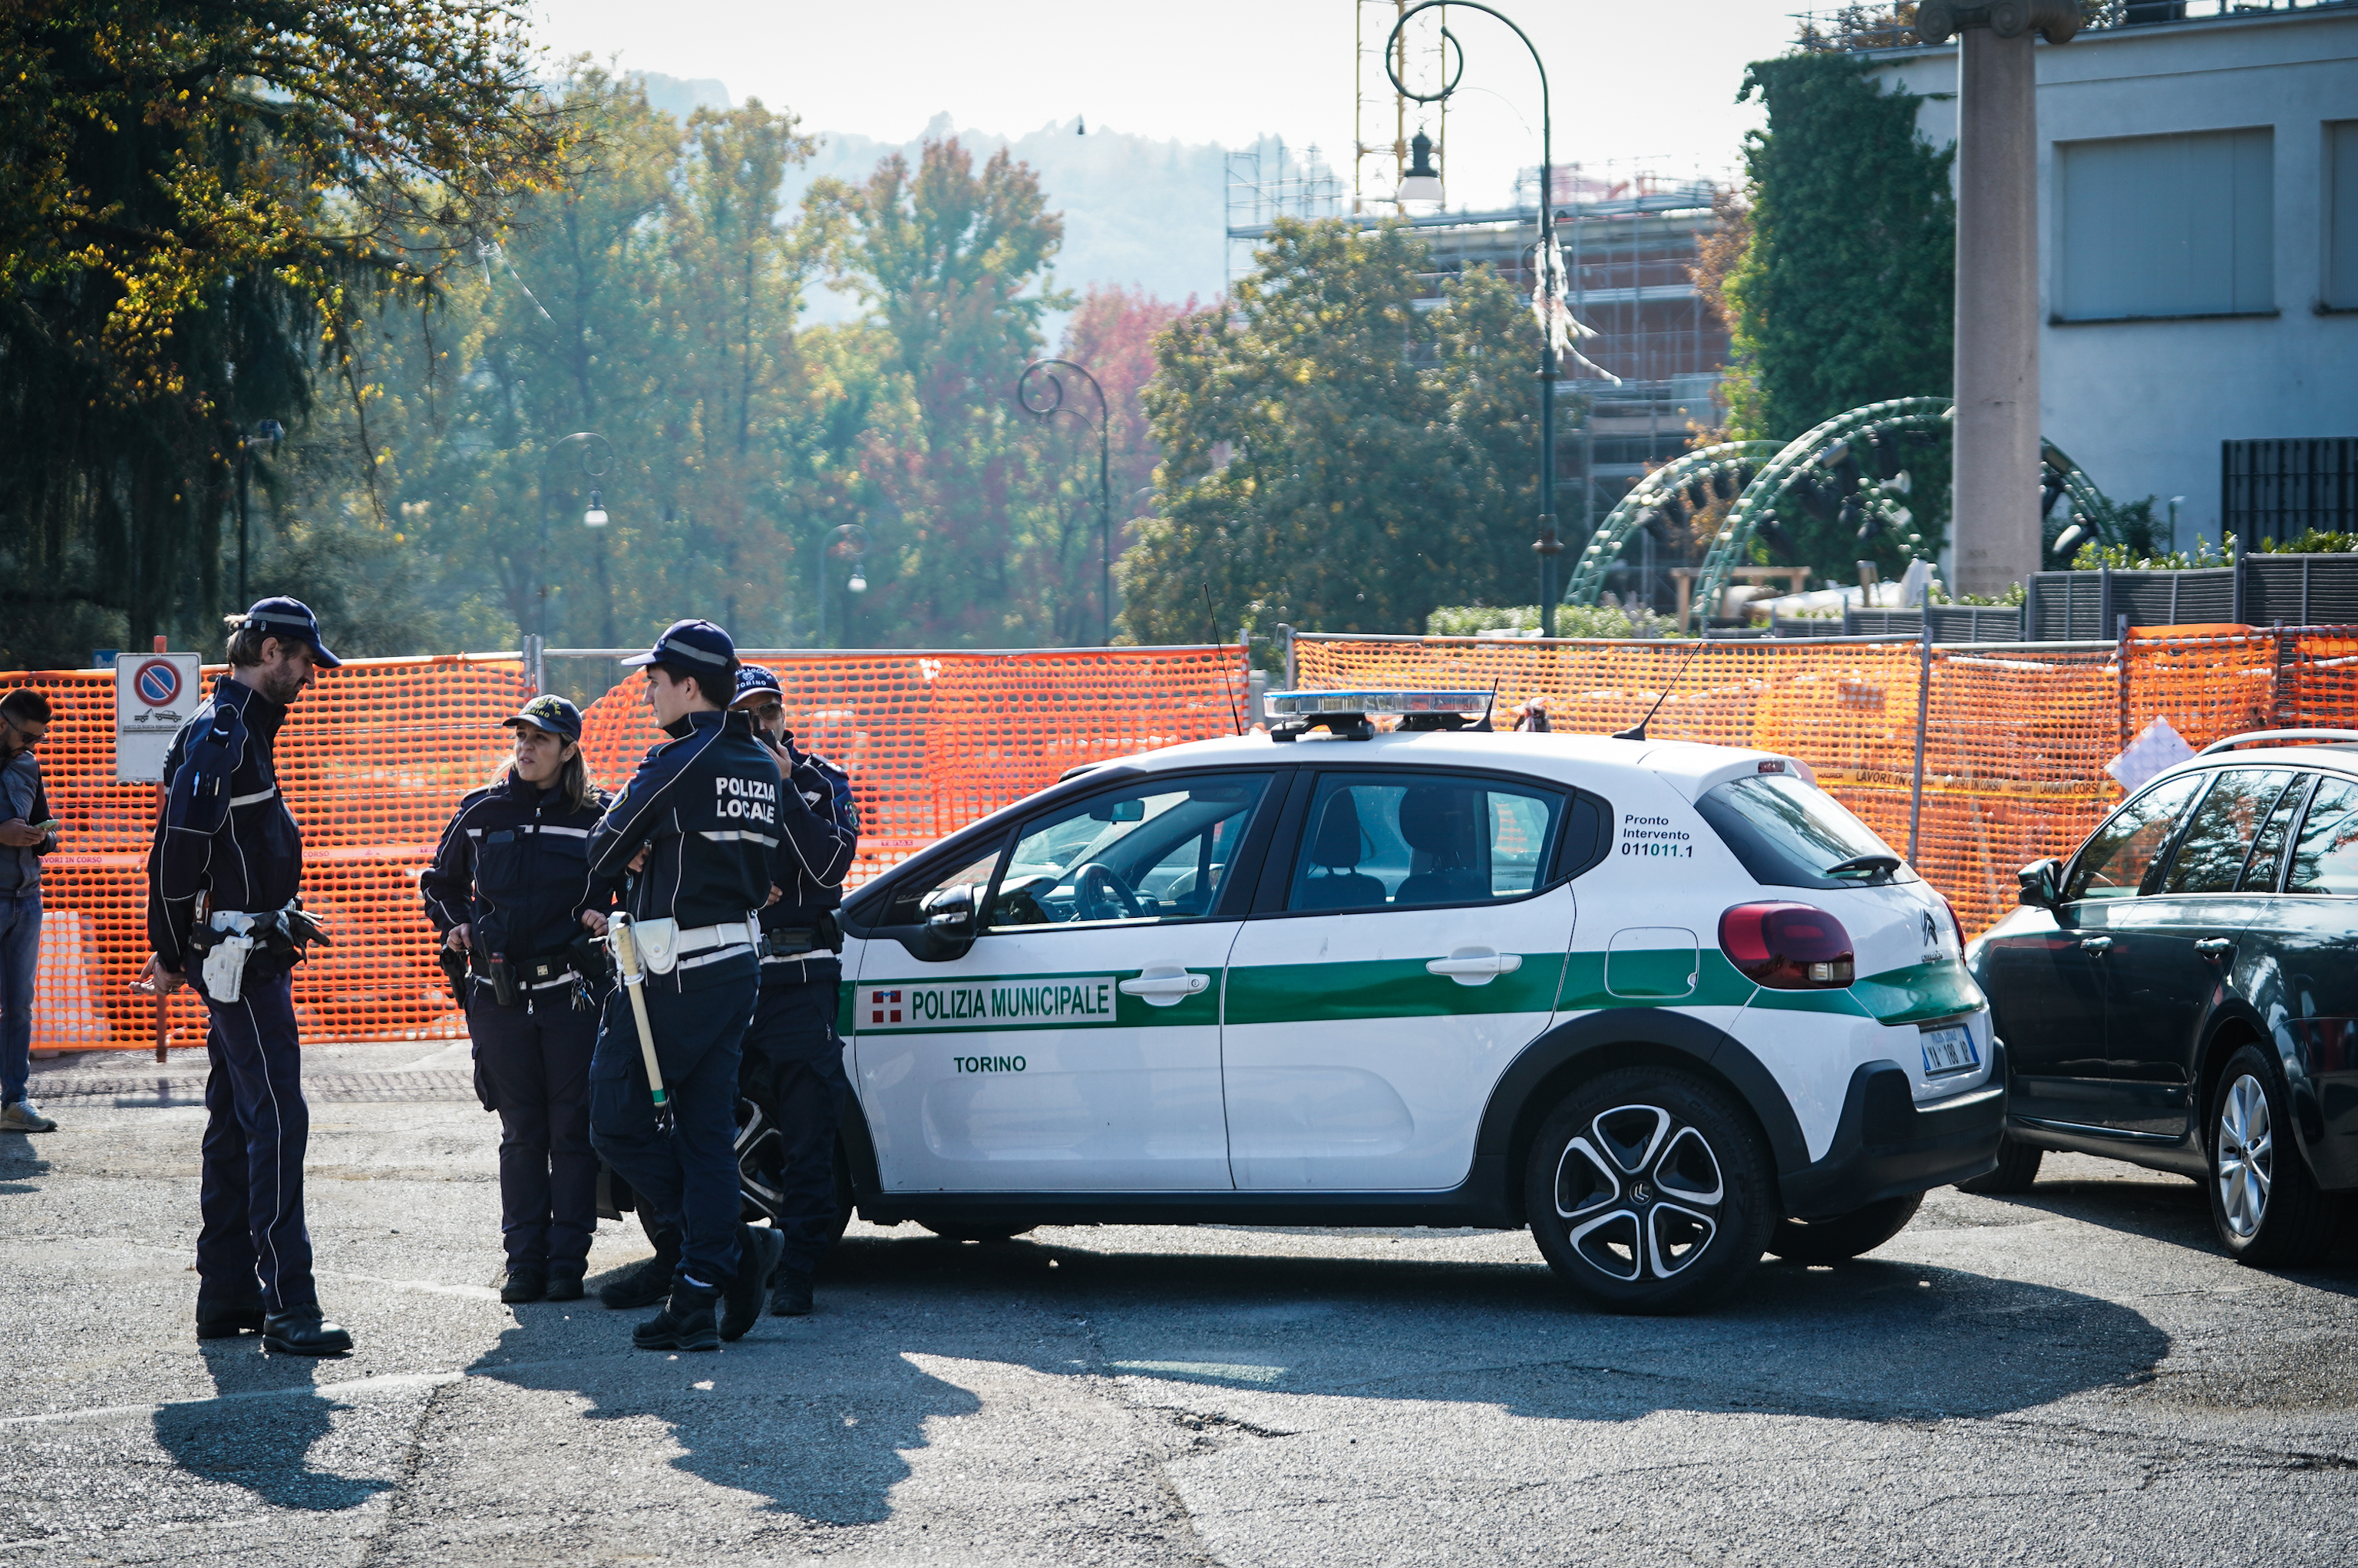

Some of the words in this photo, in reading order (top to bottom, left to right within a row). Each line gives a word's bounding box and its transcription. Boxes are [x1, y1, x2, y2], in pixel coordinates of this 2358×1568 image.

[747, 667, 772, 679] LOCALE
[1856, 771, 1891, 784] LAVORI
[1894, 774, 1906, 785] IN
[1944, 778, 1968, 790] LAVORI
[1970, 780, 1980, 791] IN
[2039, 782, 2063, 794] LAVORI
[2065, 783, 2072, 794] IN
[2073, 782, 2101, 794] CORSO
[715, 777, 775, 803] POLIZIA
[716, 798, 775, 824] LOCALE
[1625, 814, 1669, 825] Pronto
[1623, 828, 1690, 840] Intervento
[1621, 842, 1693, 858] 011011.1
[40, 856, 63, 864] AVORI
[913, 989, 986, 1020] POLIZIA
[991, 984, 1110, 1017] MUNICIPALE
[953, 1055, 1027, 1073] TORINO
